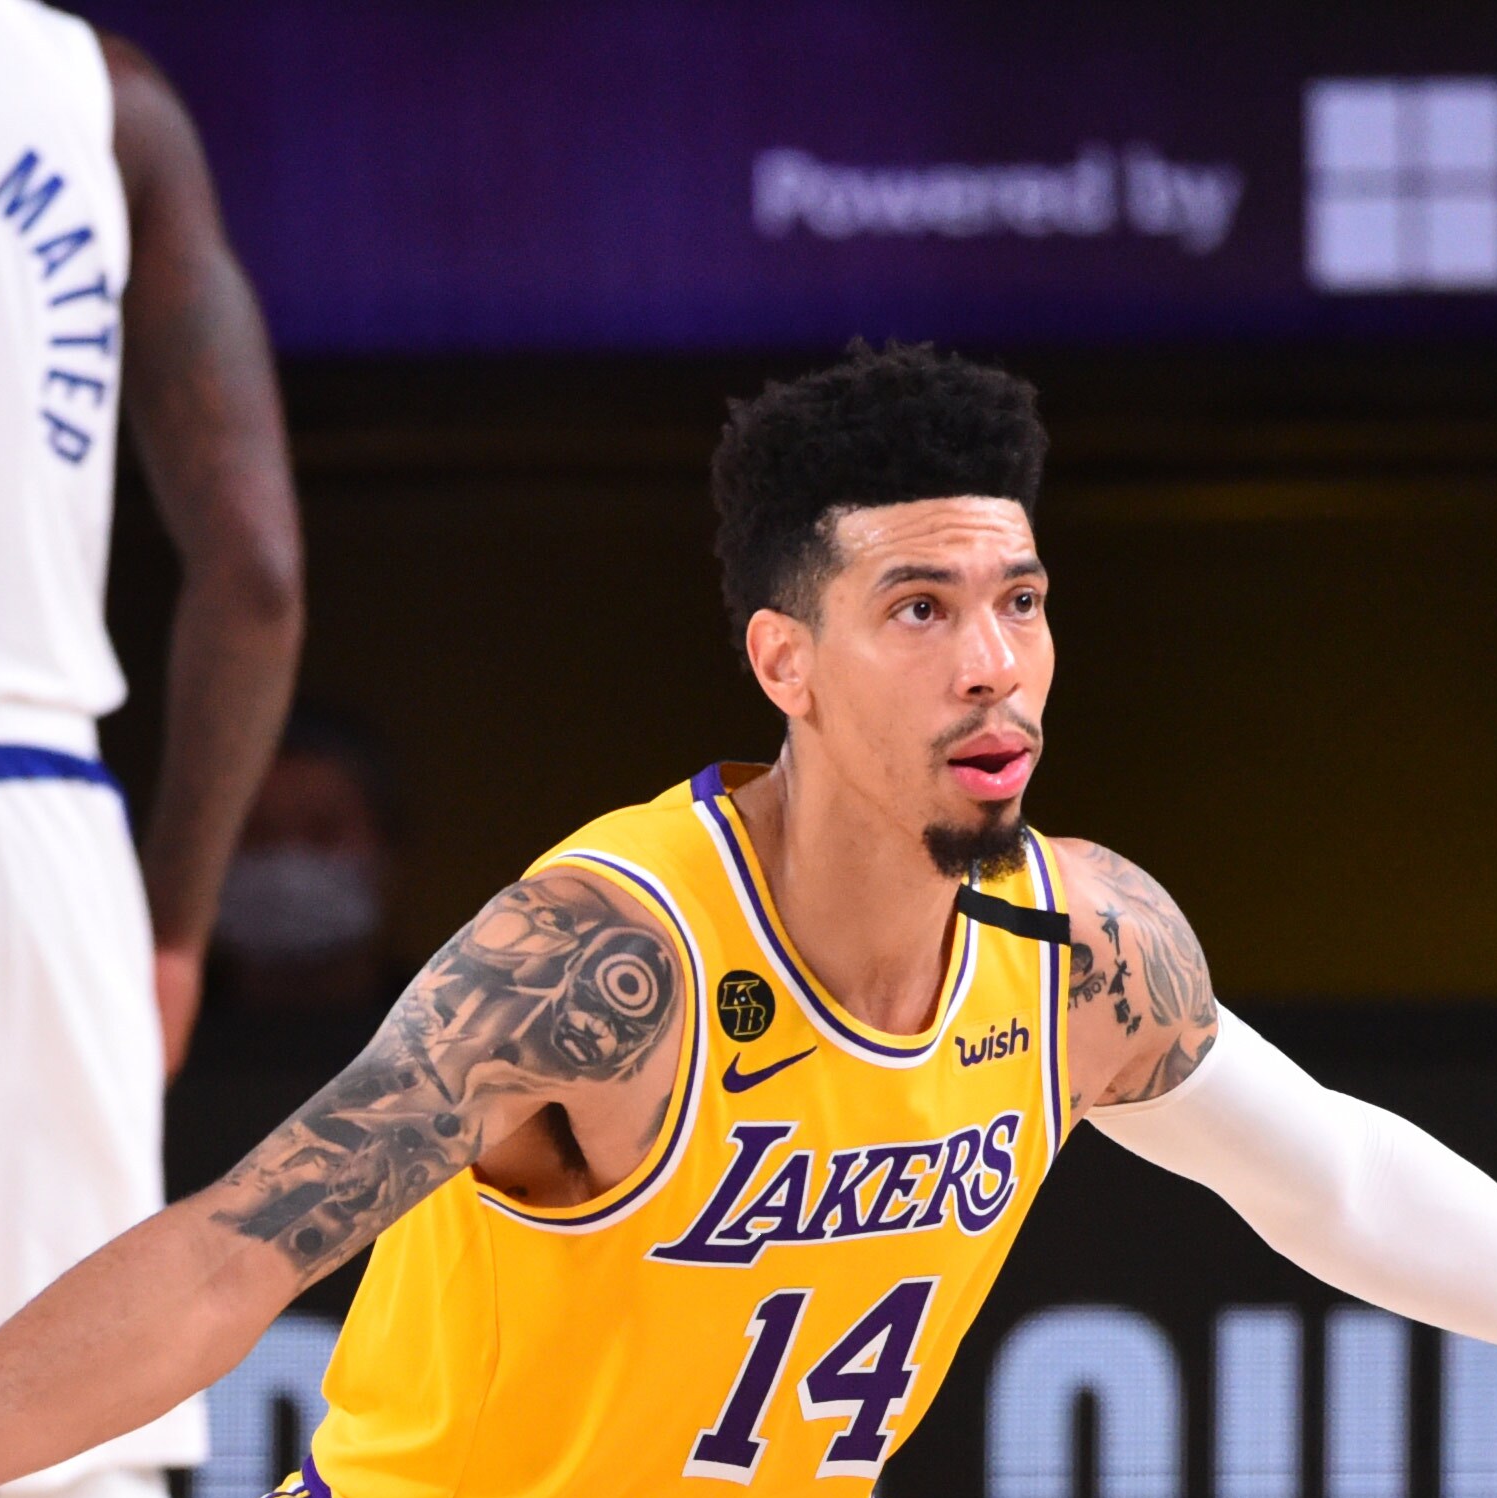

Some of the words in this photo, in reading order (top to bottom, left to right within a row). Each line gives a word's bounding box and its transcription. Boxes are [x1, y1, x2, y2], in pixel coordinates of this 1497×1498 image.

[751, 147, 1116, 238] Powered
[1122, 140, 1244, 255] by
[954, 1017, 1030, 1068] wish
[646, 1112, 1020, 1266] LAKERS
[682, 1275, 942, 1487] 14
